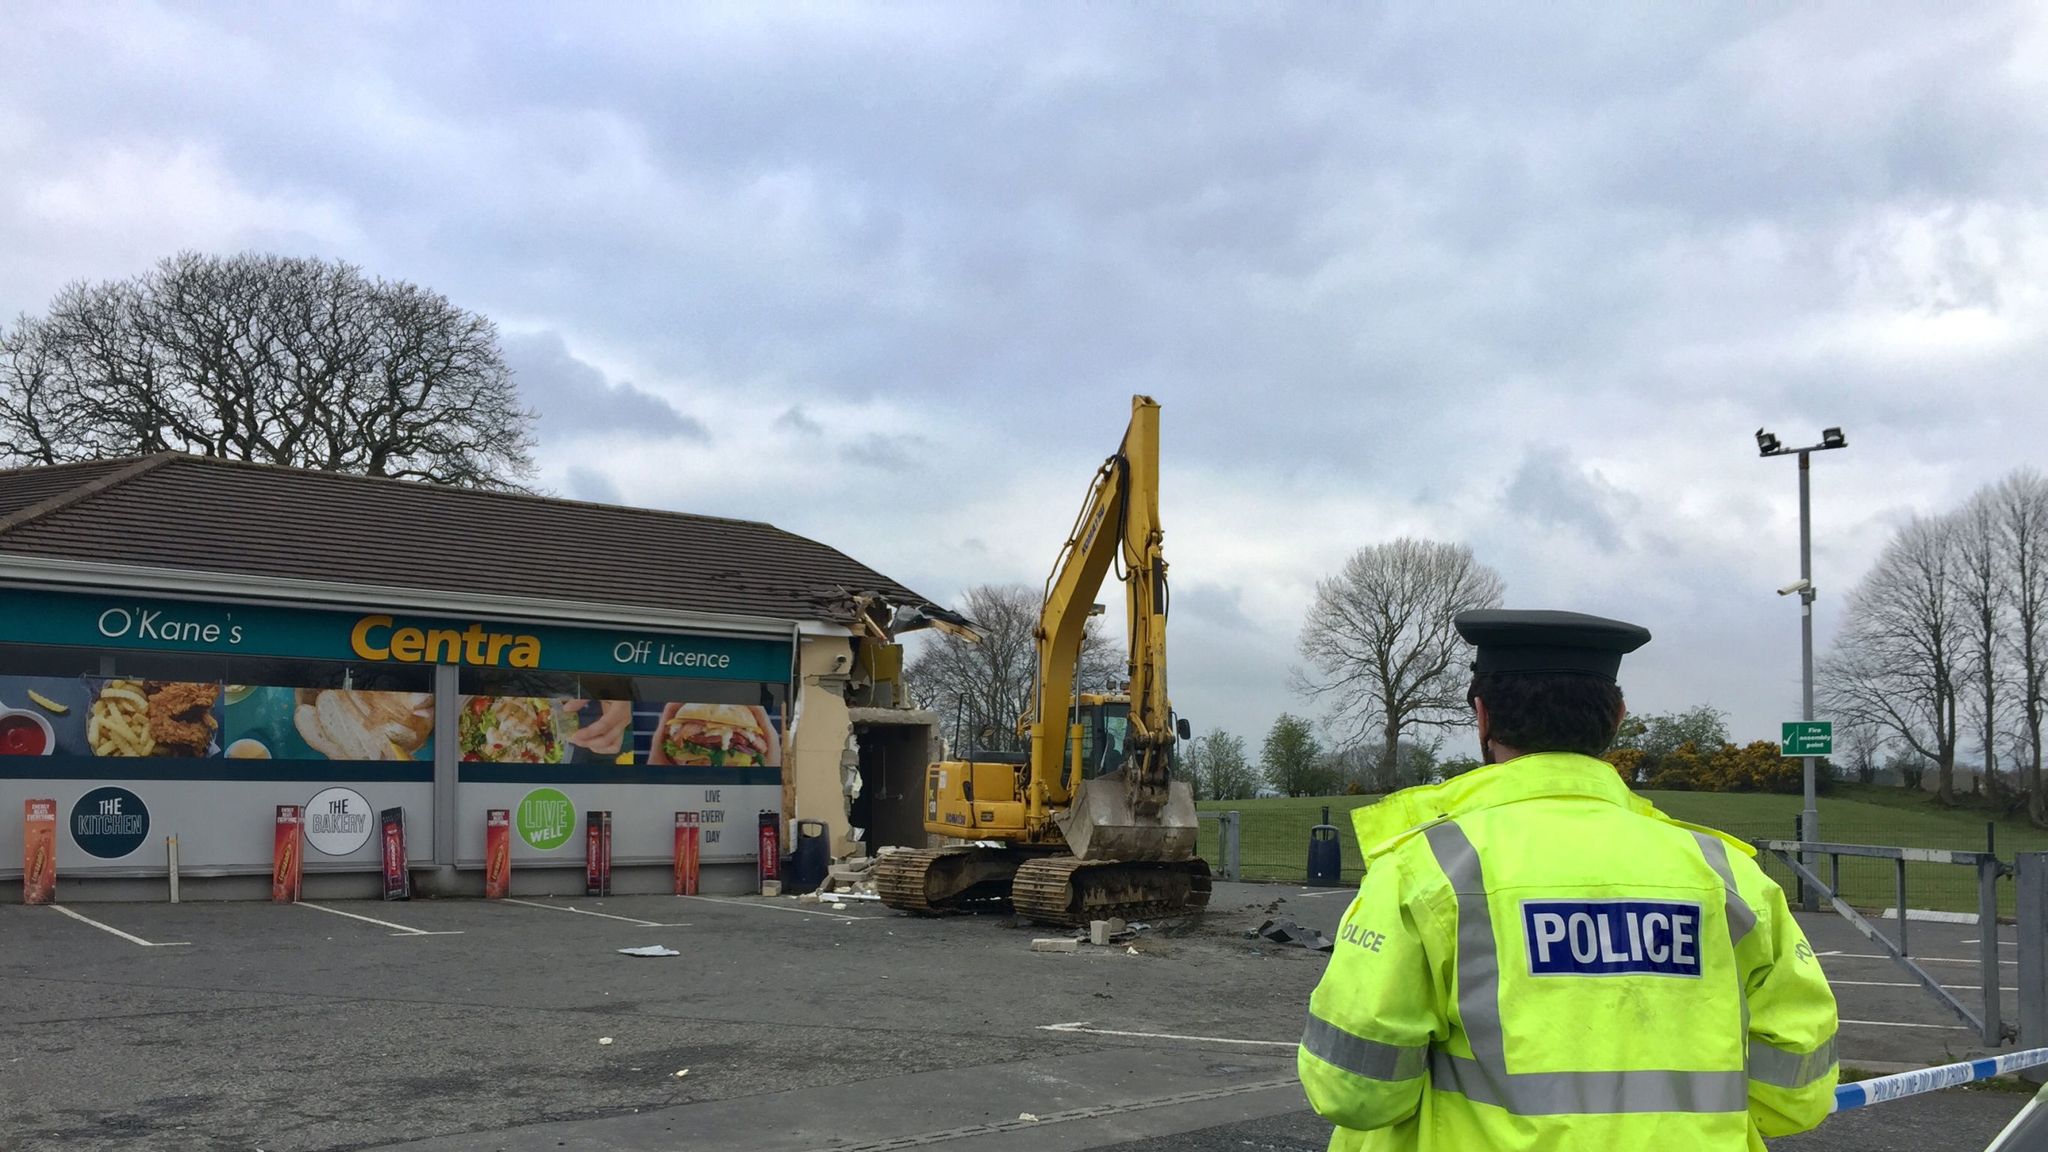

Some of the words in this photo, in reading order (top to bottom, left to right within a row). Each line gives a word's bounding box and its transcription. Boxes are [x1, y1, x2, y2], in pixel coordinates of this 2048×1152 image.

[98, 607, 243, 644] O'Kane's
[351, 615, 541, 667] Centra
[613, 641, 651, 664] Off
[659, 644, 730, 668] Licence
[99, 798, 122, 815] THE
[328, 799, 349, 814] THE
[705, 790, 720, 803] LIVE
[313, 814, 366, 833] BAKERY
[525, 800, 568, 828] LIVE
[701, 810, 725, 823] EVERY
[78, 815, 142, 835] KITCHEN
[530, 827, 563, 843] WELL
[706, 830, 720, 843] DAY
[1341, 924, 1386, 953] OLICE
[1533, 912, 1695, 964] POLICE
[1872, 1078, 1900, 1102] POLICE
[1900, 1075, 1917, 1096] LINE
[1918, 1072, 1930, 1092] DO
[1930, 1069, 1945, 1089] NOT
[1945, 1064, 1970, 1086] CROSS
